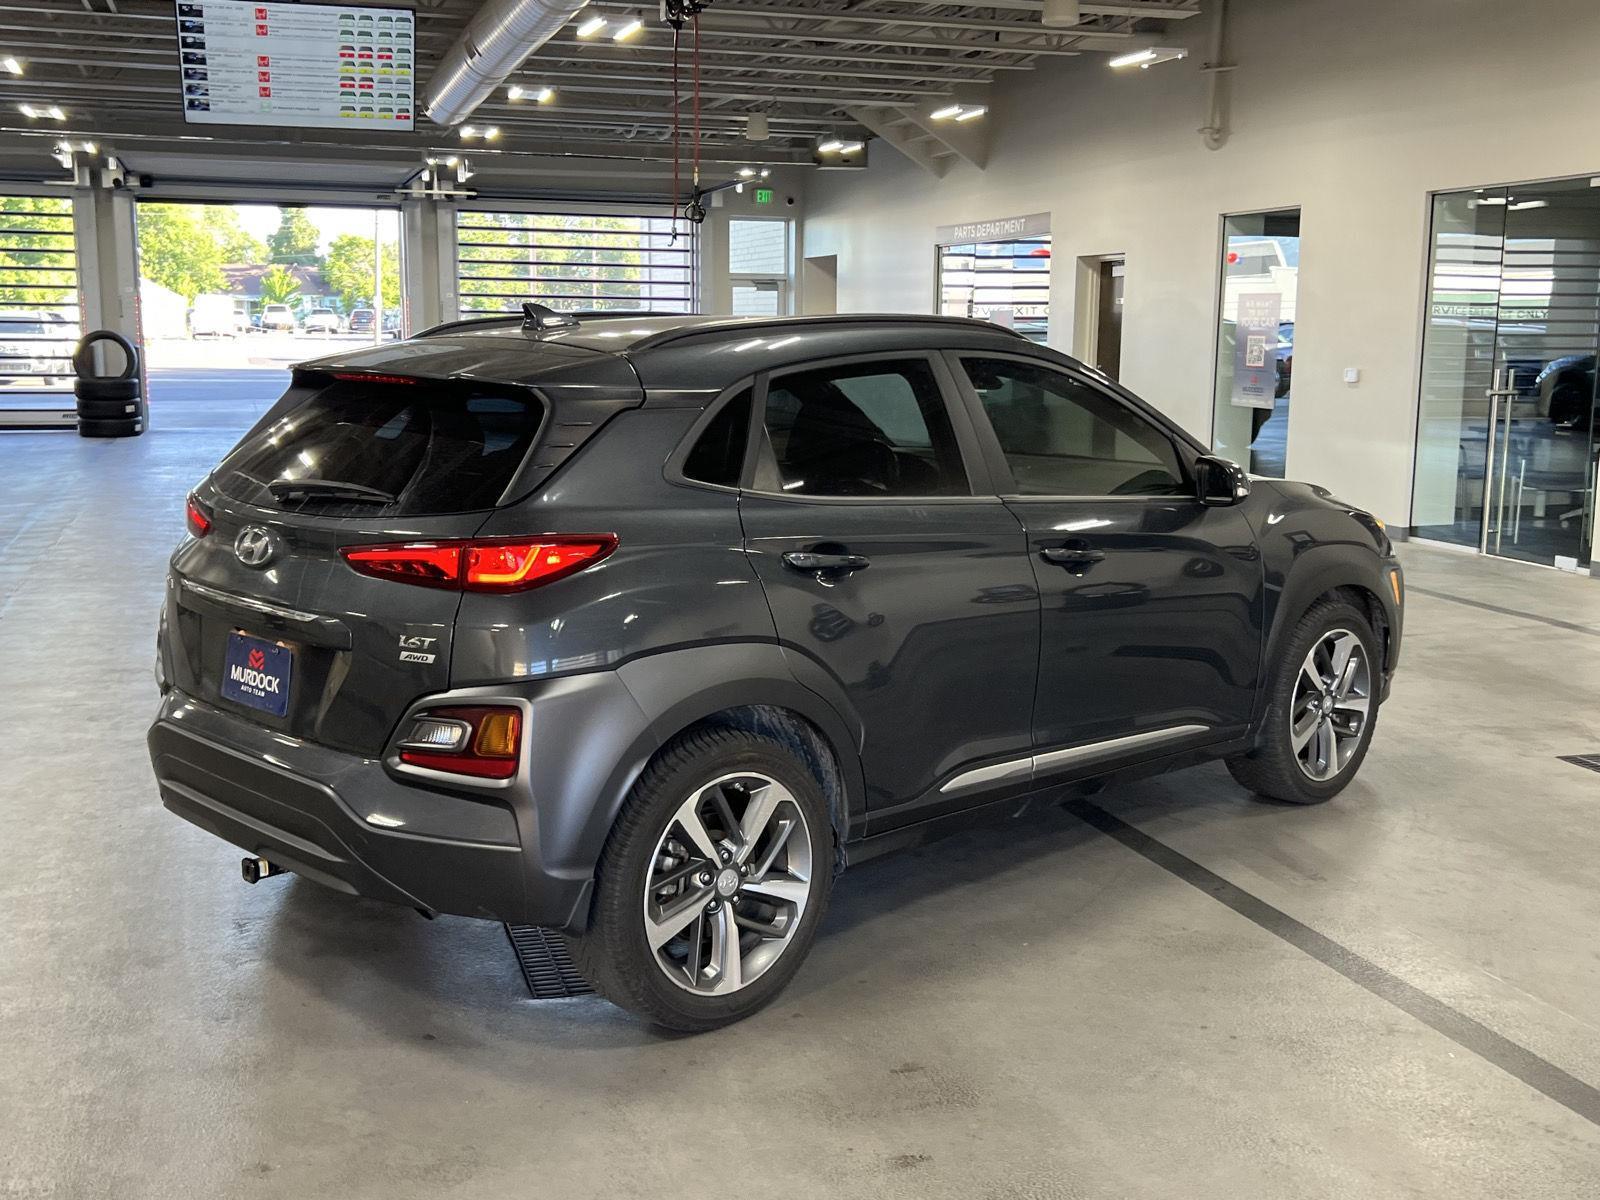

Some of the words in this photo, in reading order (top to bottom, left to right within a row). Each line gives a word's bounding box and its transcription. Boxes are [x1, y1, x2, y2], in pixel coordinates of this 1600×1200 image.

[757, 190, 773, 202] EXIT
[953, 225, 976, 239] PARTS
[976, 218, 1026, 237] DEPARTMENT
[403, 653, 429, 662] AWD
[230, 663, 280, 694] MURDOCK
[240, 684, 252, 693] AUTO
[252, 688, 266, 698] TEAM
